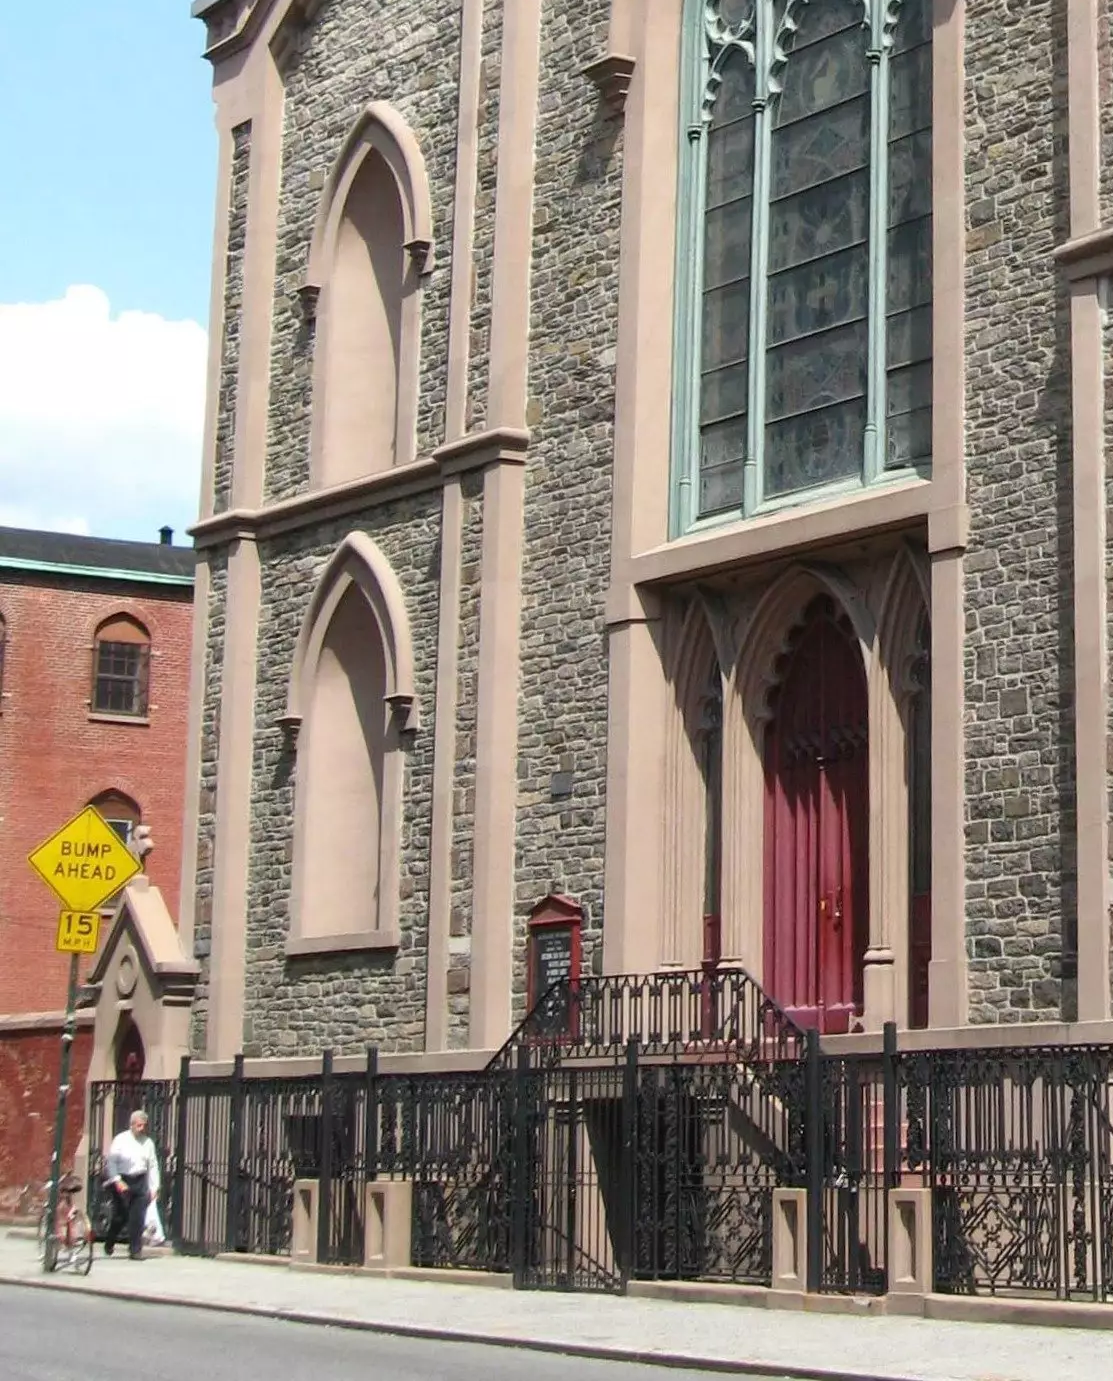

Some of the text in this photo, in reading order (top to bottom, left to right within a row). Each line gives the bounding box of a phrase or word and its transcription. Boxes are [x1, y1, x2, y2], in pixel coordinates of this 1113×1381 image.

[61, 841, 112, 858] BUMP
[54, 862, 116, 881] AHEAD
[65, 914, 93, 936] 15
[63, 938, 91, 947] MPH
